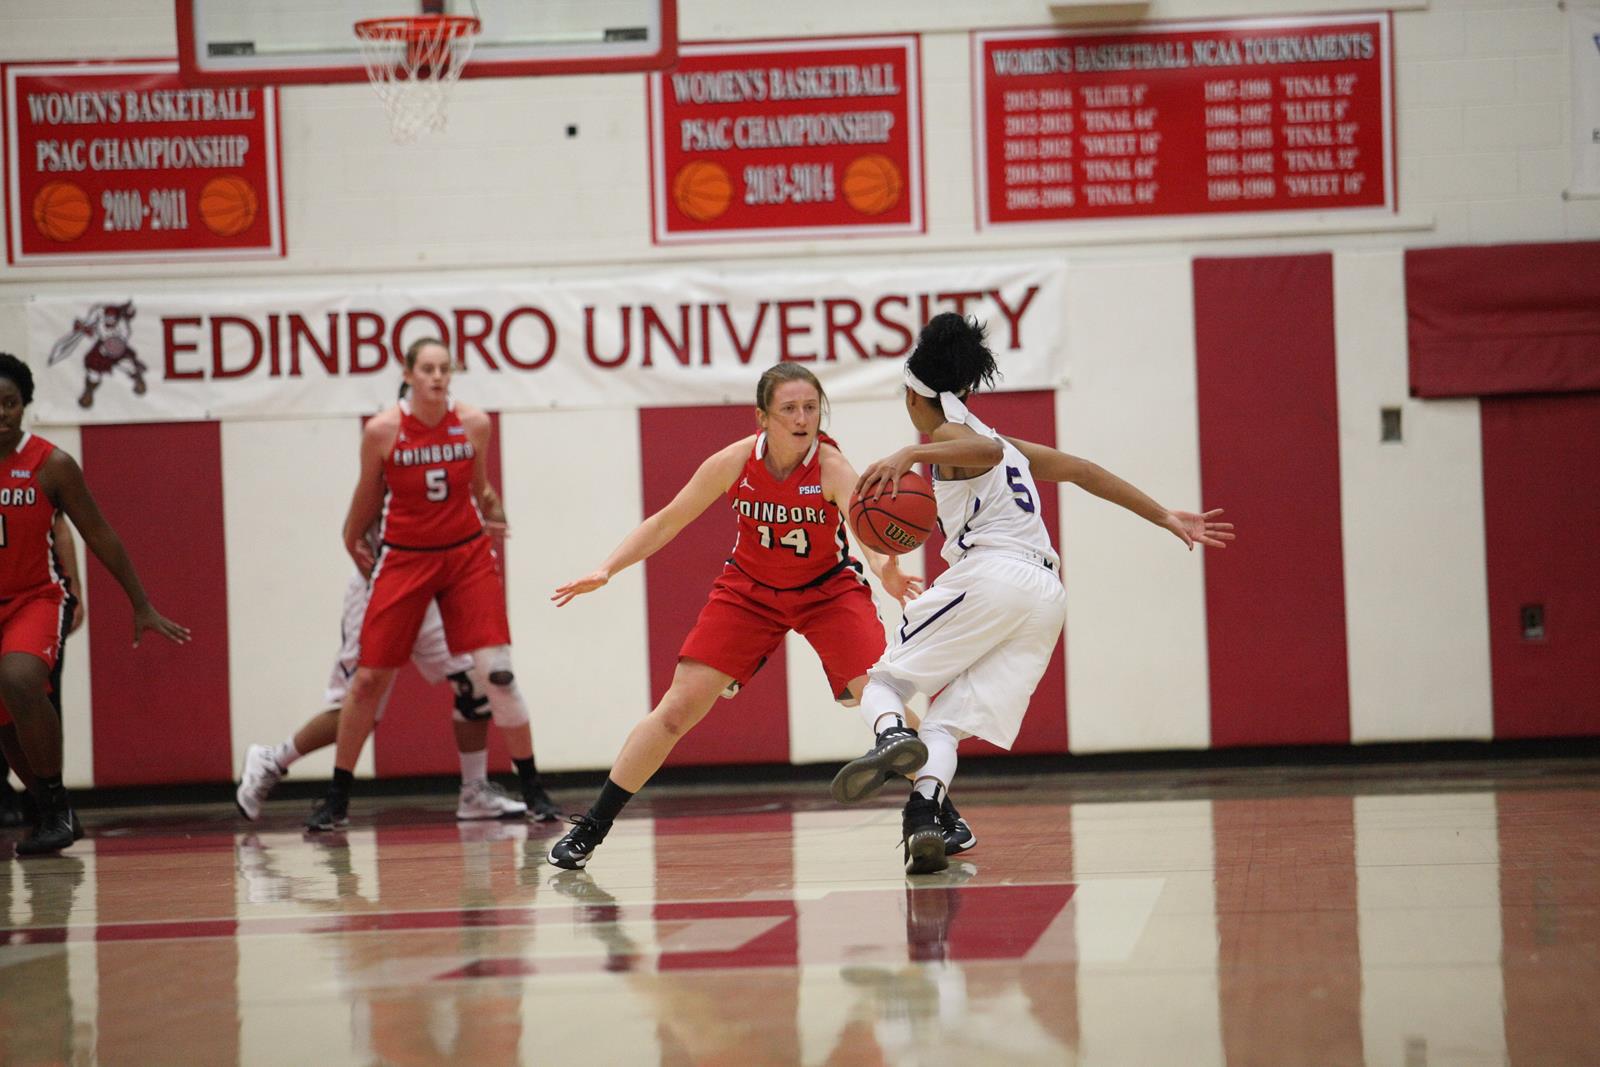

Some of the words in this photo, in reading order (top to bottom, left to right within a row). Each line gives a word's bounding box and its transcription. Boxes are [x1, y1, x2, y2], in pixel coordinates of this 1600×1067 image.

[993, 47, 1073, 75] WOMEN'S
[1075, 42, 1189, 72] BASKETBALL
[1192, 38, 1240, 66] NCAA
[1243, 32, 1374, 64] TOURNAMENTS
[673, 69, 767, 104] WOMEN'S
[769, 64, 899, 100] BASKETBALL
[28, 91, 121, 124] WOMEN'S
[125, 86, 255, 123] BASKETBALL
[680, 117, 732, 151] PSAC
[734, 110, 894, 149] CHAMPIONSHIP
[37, 139, 86, 172] PSAC
[89, 135, 250, 171] CHAMPIONSHIP
[743, 162, 836, 205] 2013-2014
[101, 188, 189, 231] 2010-2011
[162, 305, 557, 381] EDINBORO
[425, 467, 449, 502] 5
[798, 485, 822, 495] PSAC
[1005, 465, 1036, 514] 5
[757, 524, 811, 558] 14
